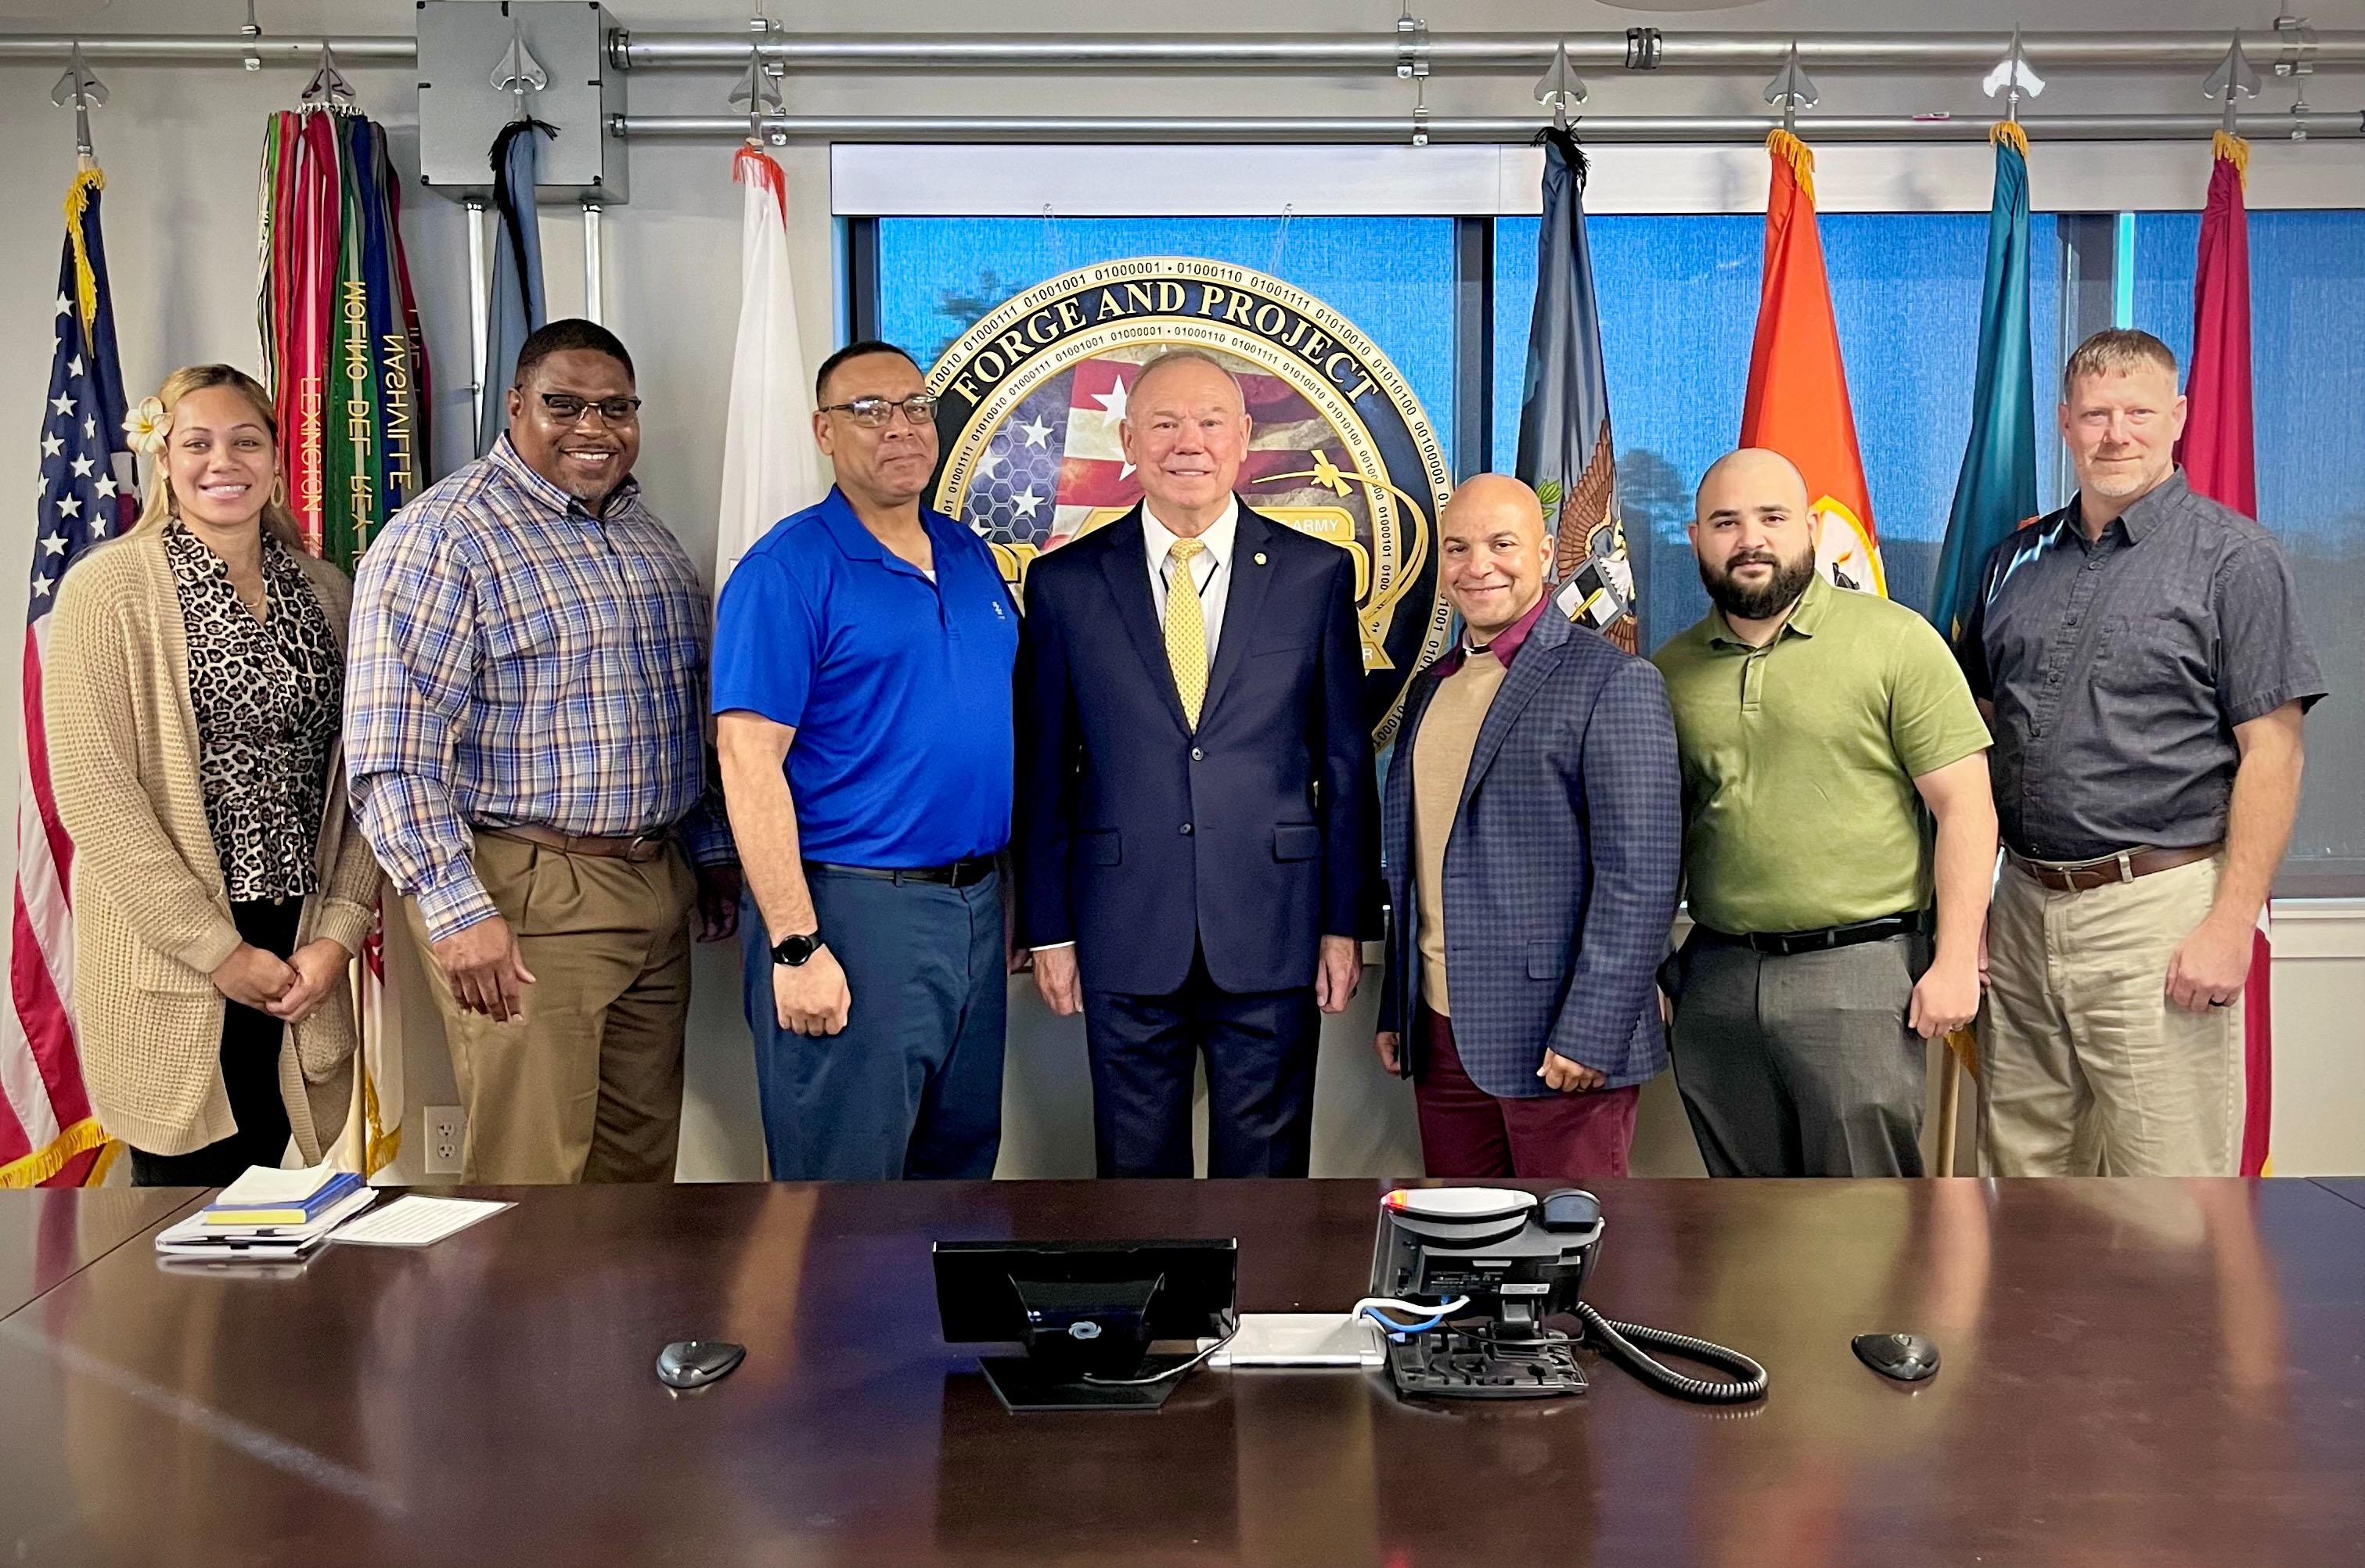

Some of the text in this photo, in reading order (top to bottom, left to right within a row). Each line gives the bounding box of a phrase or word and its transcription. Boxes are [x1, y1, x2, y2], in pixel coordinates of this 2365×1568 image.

[926, 353, 962, 396] 010010
[963, 305, 1018, 351] 01000111
[1024, 274, 1087, 308] 01001001
[1095, 261, 1161, 281] 01000001
[1177, 262, 1243, 282] 01000110
[1250, 276, 1311, 311] 01001111
[1316, 308, 1371, 356] 01010010
[1372, 359, 1416, 416] 01010100
[1414, 421, 1445, 484] 00100000
[950, 281, 1380, 408] FORGE AND PROJECT
[300, 377, 322, 512] LEXINGTON
[948, 446, 974, 494] 01001111
[971, 397, 1007, 442] 01010010
[1009, 360, 1052, 396] 01000111
[1055, 335, 1104, 362] 01001001
[1111, 326, 1162, 341] 01000001
[1174, 326, 1226, 343] 01000110
[1231, 337, 1279, 365] 01001111
[1283, 361, 1326, 400] 01010010
[1326, 401, 1362, 447] 01010100
[1378, 506, 1391, 558] 01000101
[1291, 519, 1339, 533] ARMY
